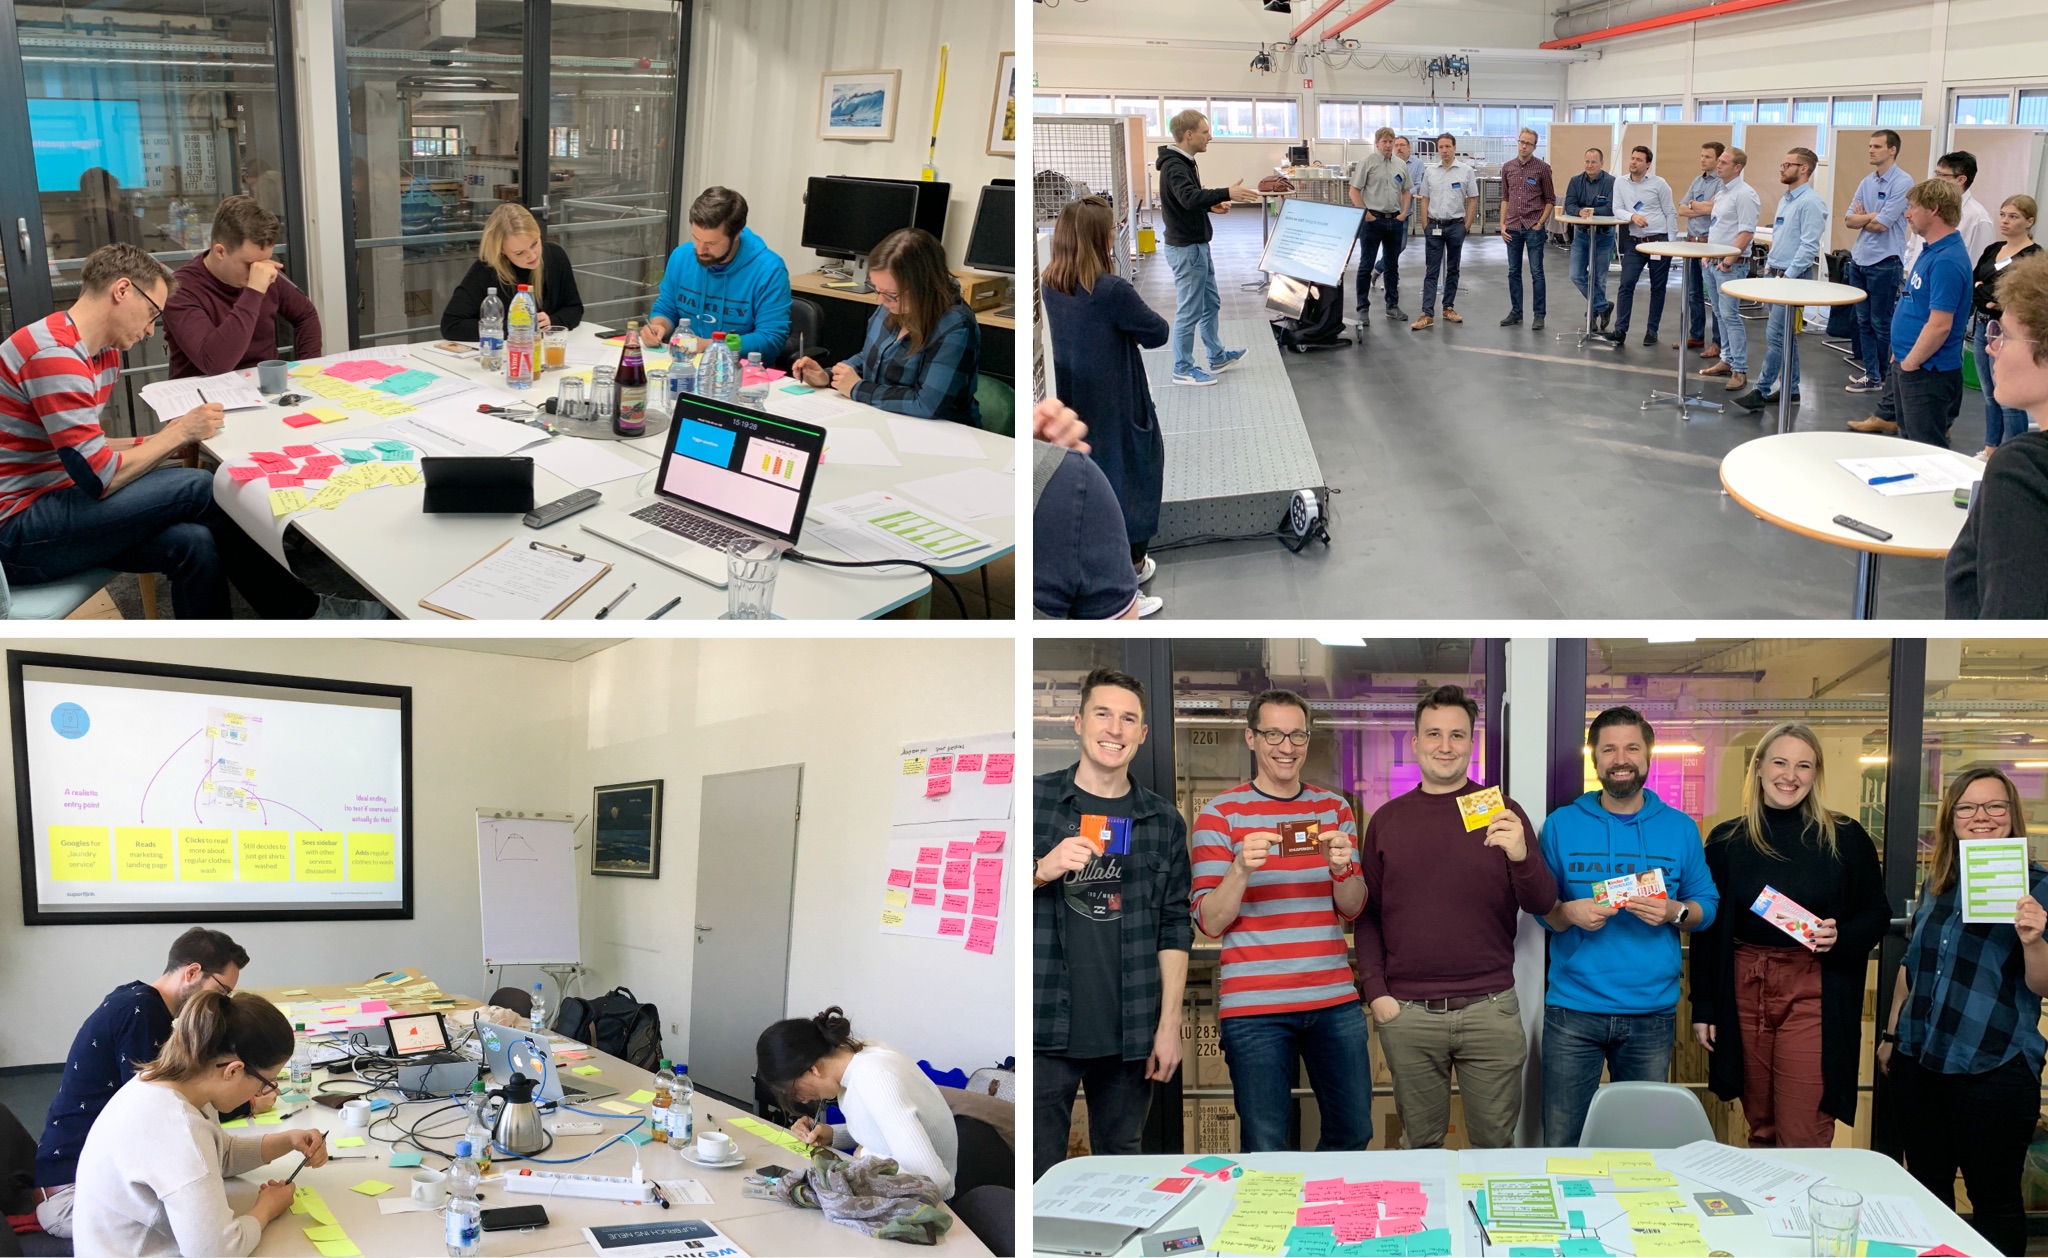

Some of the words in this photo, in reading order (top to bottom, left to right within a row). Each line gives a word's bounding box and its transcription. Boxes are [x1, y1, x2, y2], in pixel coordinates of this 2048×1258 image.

[678, 294, 748, 318] OAKLEY
[733, 418, 758, 430] 15:19:28
[369, 795, 387, 803] ending
[651, 1226, 698, 1235] AUFBRUCH
[608, 1232, 634, 1240] NEUE
